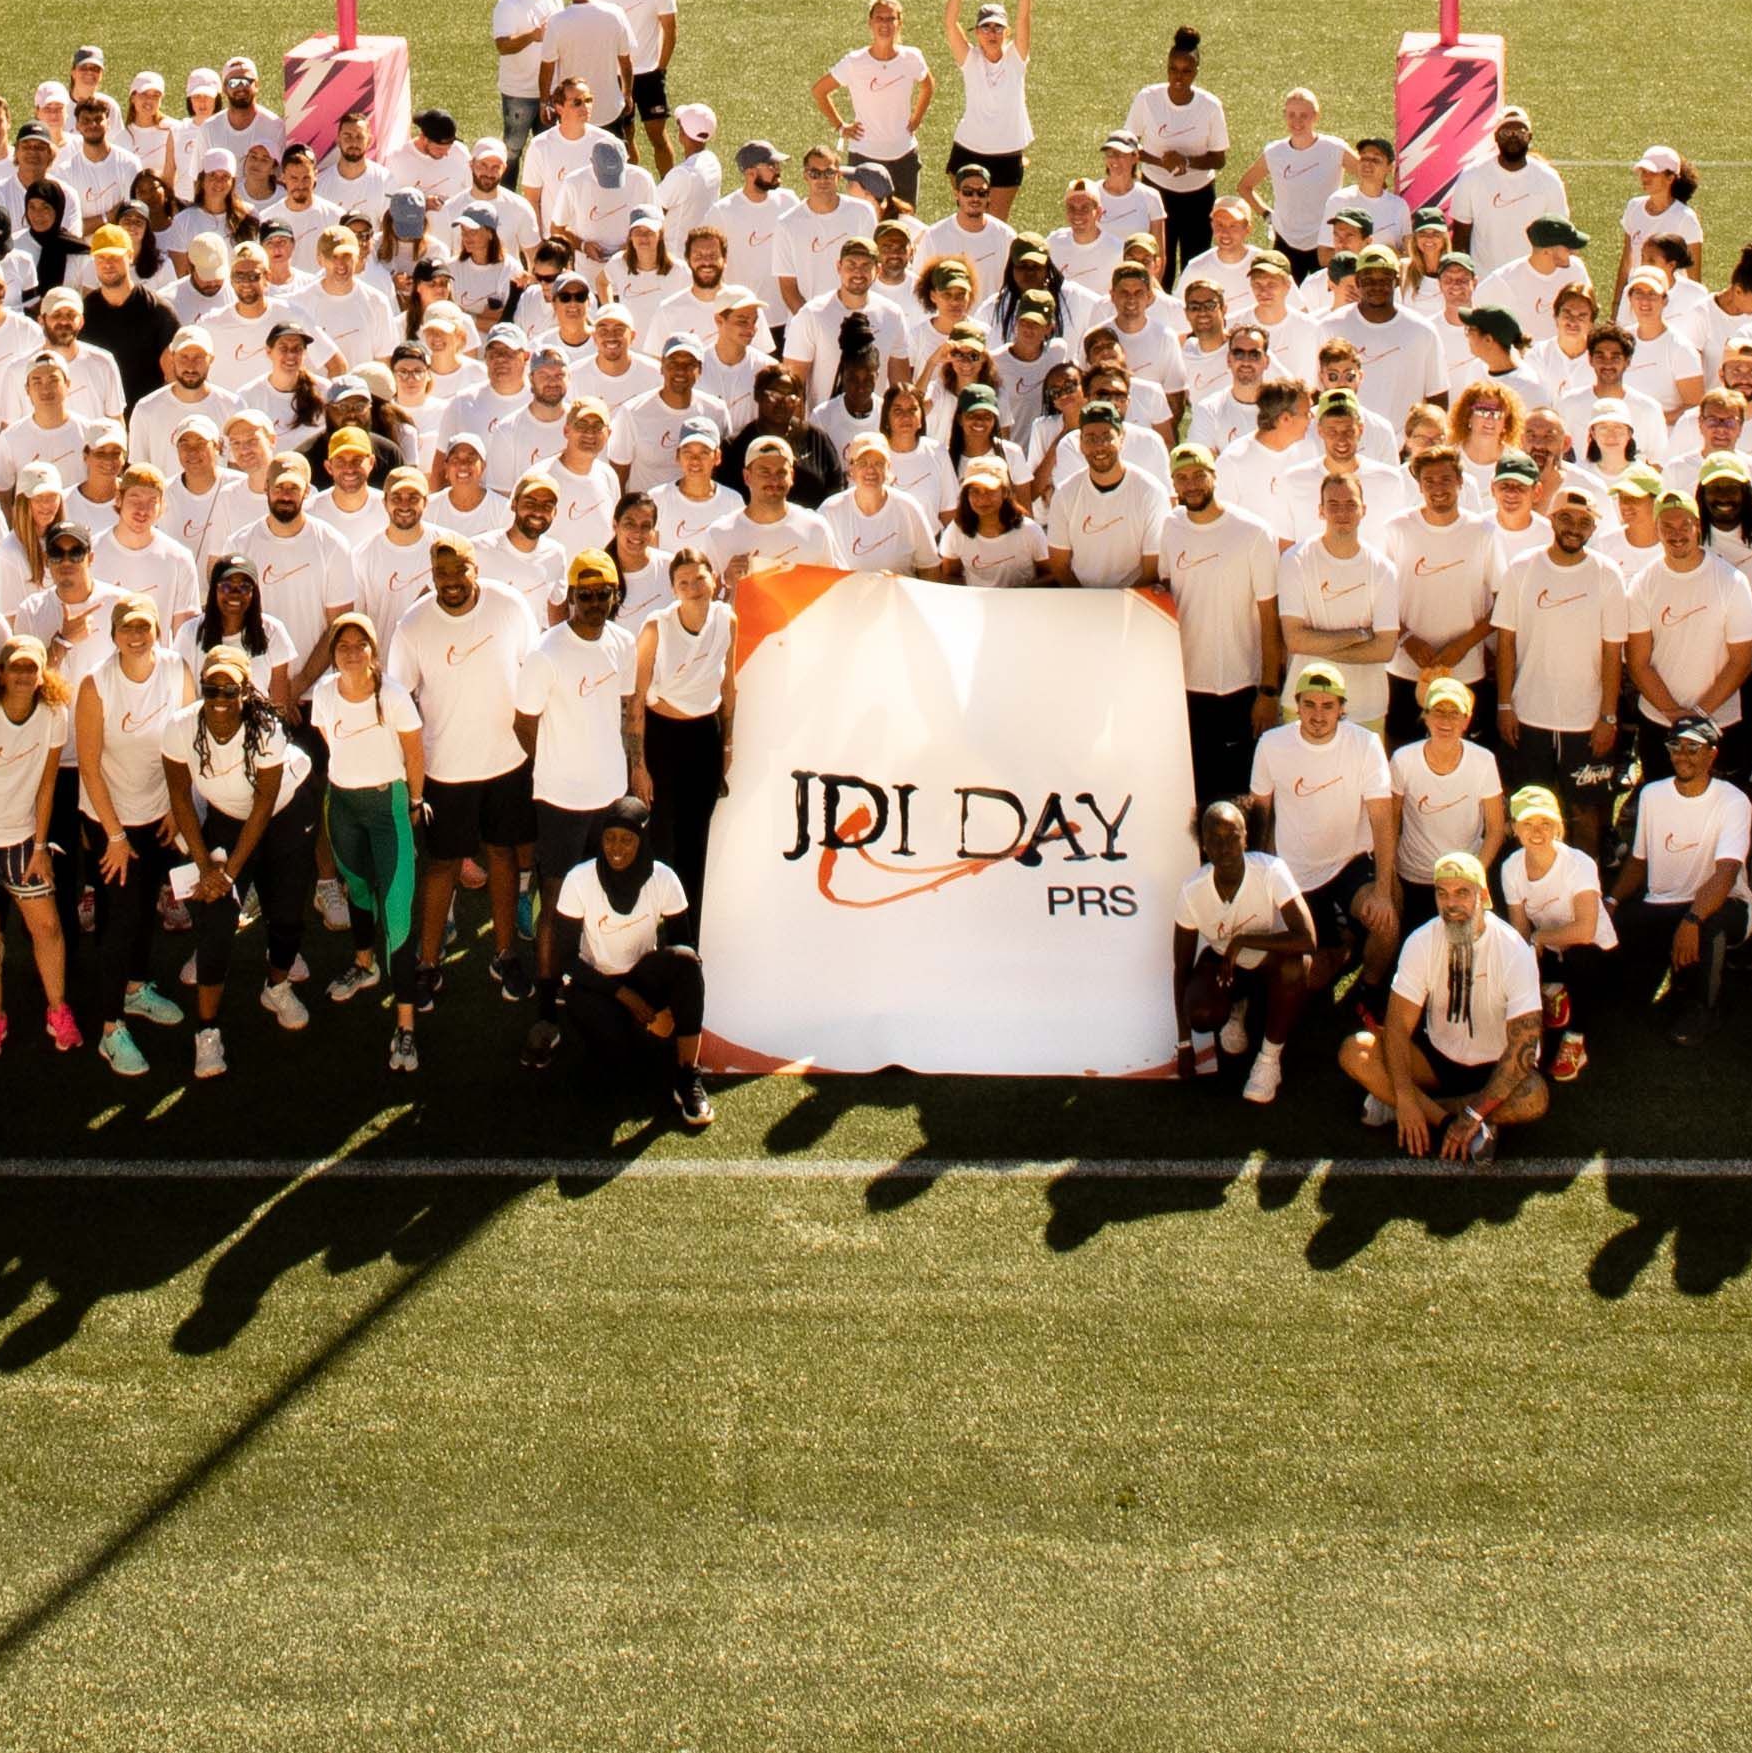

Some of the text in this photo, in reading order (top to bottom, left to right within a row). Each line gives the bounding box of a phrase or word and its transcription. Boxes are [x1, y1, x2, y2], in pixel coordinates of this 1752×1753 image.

[782, 768, 1134, 868] JDI DAY
[1046, 885, 1139, 918] PRS
